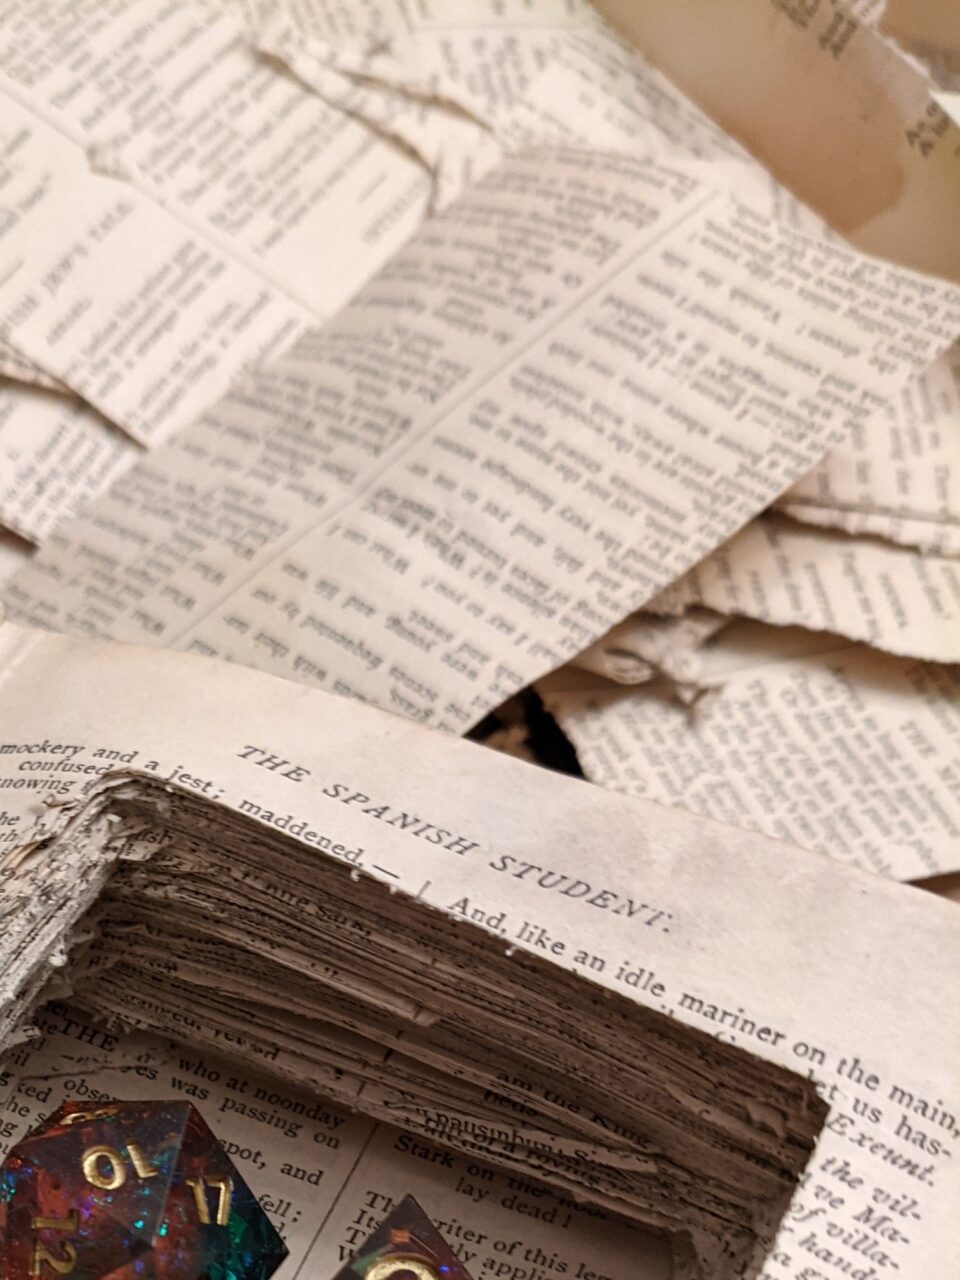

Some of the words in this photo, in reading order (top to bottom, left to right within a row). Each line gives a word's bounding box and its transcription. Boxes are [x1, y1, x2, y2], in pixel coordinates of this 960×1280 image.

[236, 743, 313, 785] THE
[320, 782, 480, 858] SPANISH
[488, 853, 675, 934] STUDENT.
[448, 895, 507, 934] And,
[517, 921, 566, 956] like
[574, 948, 605, 973] an
[615, 963, 666, 999] idle
[678, 990, 786, 1047] mariner
[793, 1036, 827, 1066] on
[836, 1059, 881, 1092] the
[170, 1077, 210, 1101] was
[220, 1090, 308, 1138] passing
[177, 1055, 221, 1085] who
[254, 1085, 347, 1128] noonday
[825, 1112, 936, 1188] Exeunt.
[851, 1094, 882, 1125] us
[894, 1116, 953, 1160] has-
[819, 1157, 865, 1190] the
[522, 1242, 568, 1271] this
